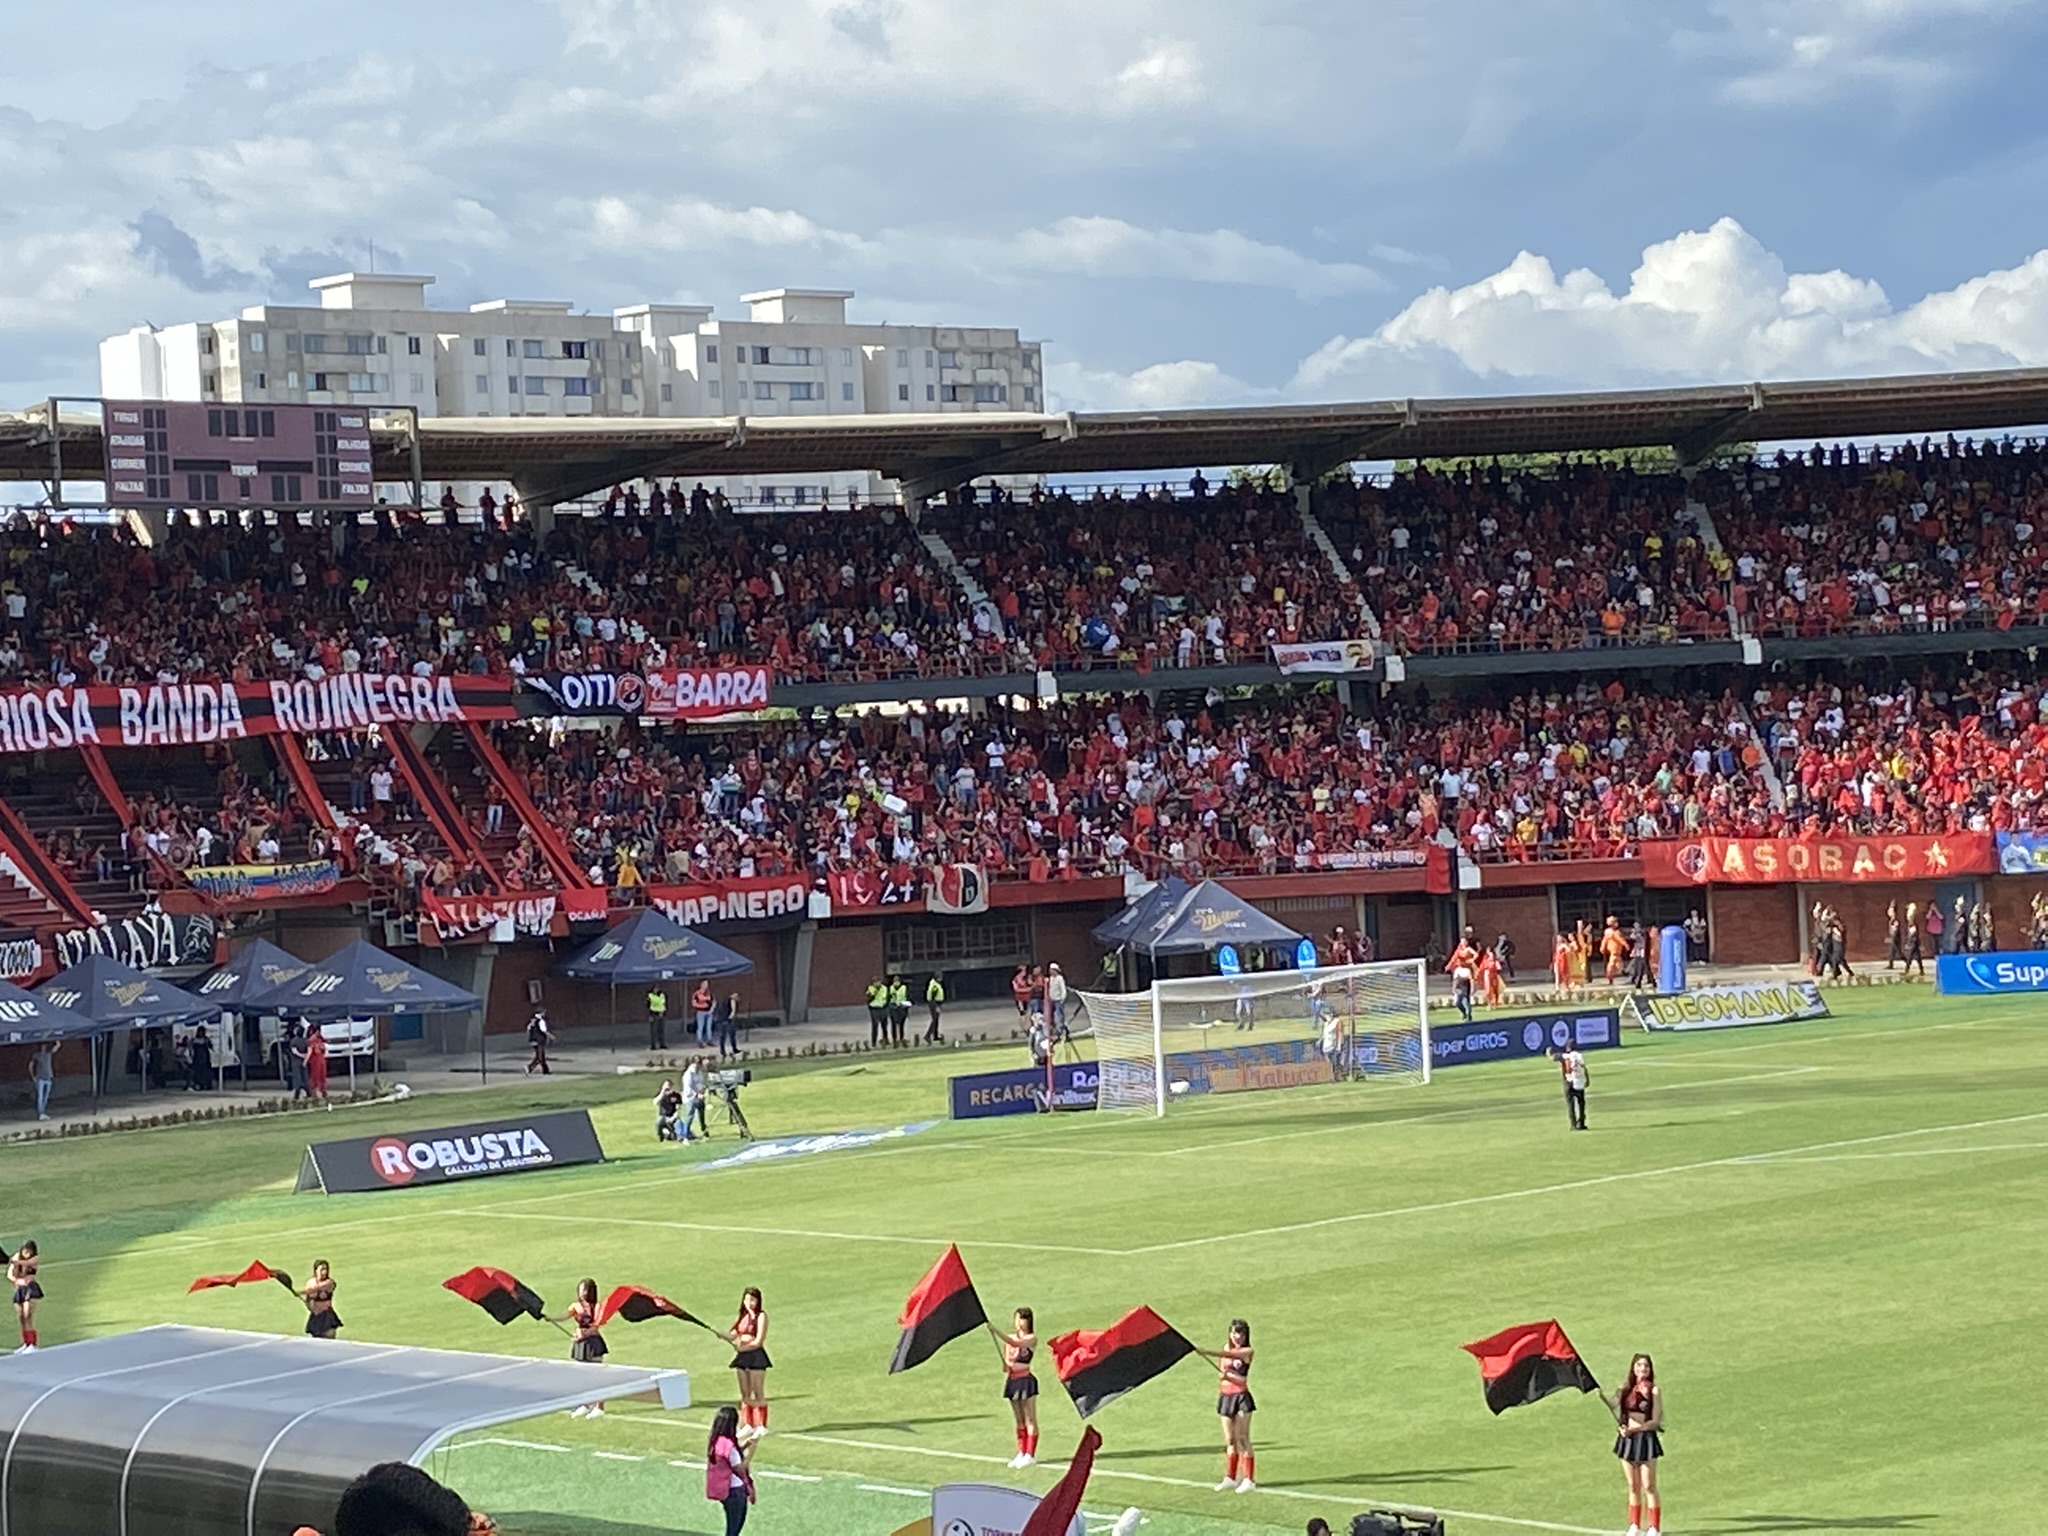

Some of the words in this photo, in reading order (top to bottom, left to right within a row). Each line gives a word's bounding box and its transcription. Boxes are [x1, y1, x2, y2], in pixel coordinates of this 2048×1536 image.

[675, 669, 768, 708] BARRA
[118, 682, 248, 746] BANDA
[270, 673, 467, 732] ROJINEGRA
[1722, 841, 1907, 874] ASOBAC
[1996, 962, 2048, 986] Sup
[375, 1128, 550, 1176] ROBUSTA
